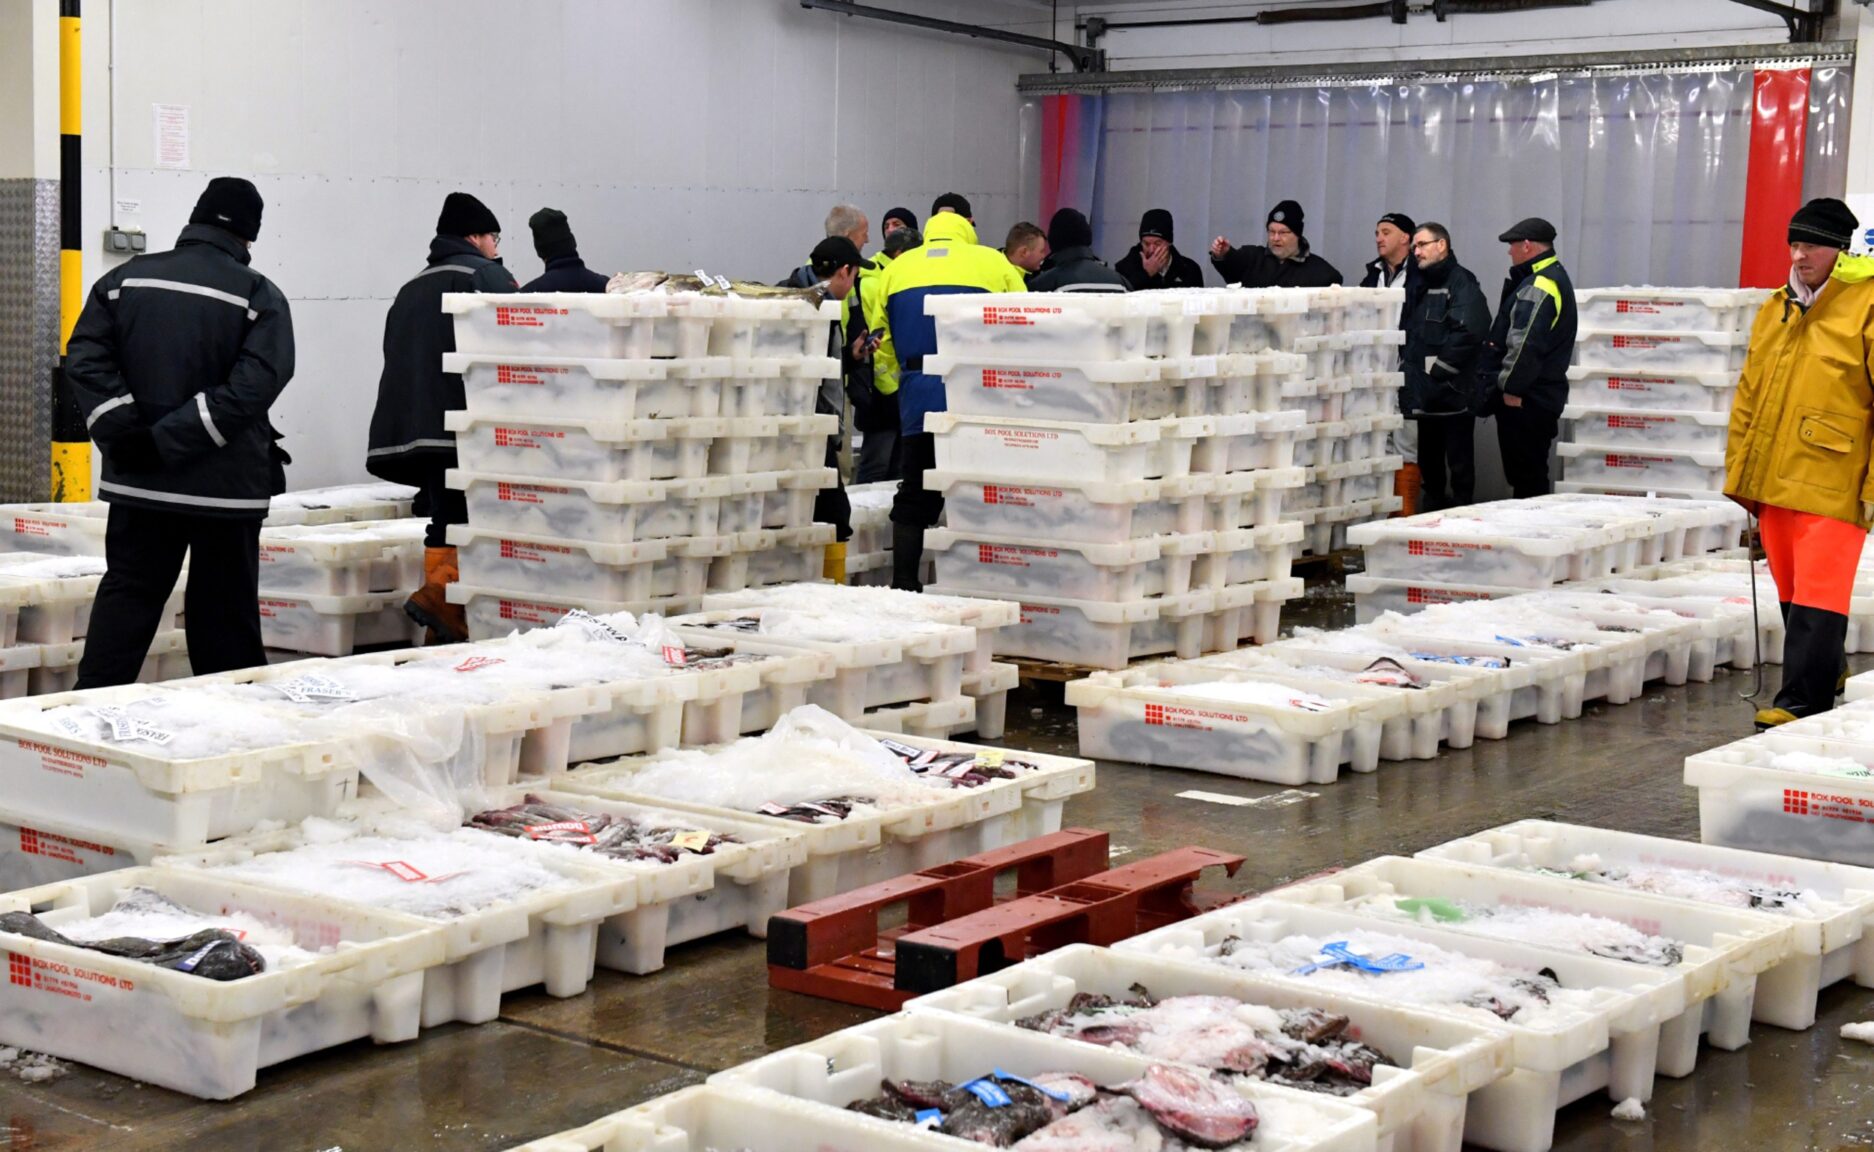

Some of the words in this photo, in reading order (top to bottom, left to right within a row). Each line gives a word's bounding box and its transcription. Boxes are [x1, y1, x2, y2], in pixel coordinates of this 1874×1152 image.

[1014, 430, 1045, 438] SOLUTIONS
[1047, 432, 1058, 440] LTD
[1024, 488, 1051, 496] SOLUTIONS
[536, 543, 560, 552] SOLUTIONS
[536, 604, 559, 613] SOLUTIONS
[1199, 711, 1233, 720] SOLUTIONS
[18, 739, 33, 751] BOX
[34, 741, 52, 756] POOL
[53, 747, 92, 765] SOLUTIONS
[93, 757, 107, 768] LTD
[1811, 792, 1828, 802] BOX
[1830, 795, 1854, 805] POOL
[39, 831, 50, 839] BOX
[51, 834, 68, 844] POOL
[70, 838, 100, 852] SOLUTIONS
[102, 846, 114, 855] LTD
[32, 958, 50, 970] BOX
[51, 962, 70, 975] POOL
[74, 968, 116, 987] SOLUTIONS
[120, 980, 134, 991] LTD
